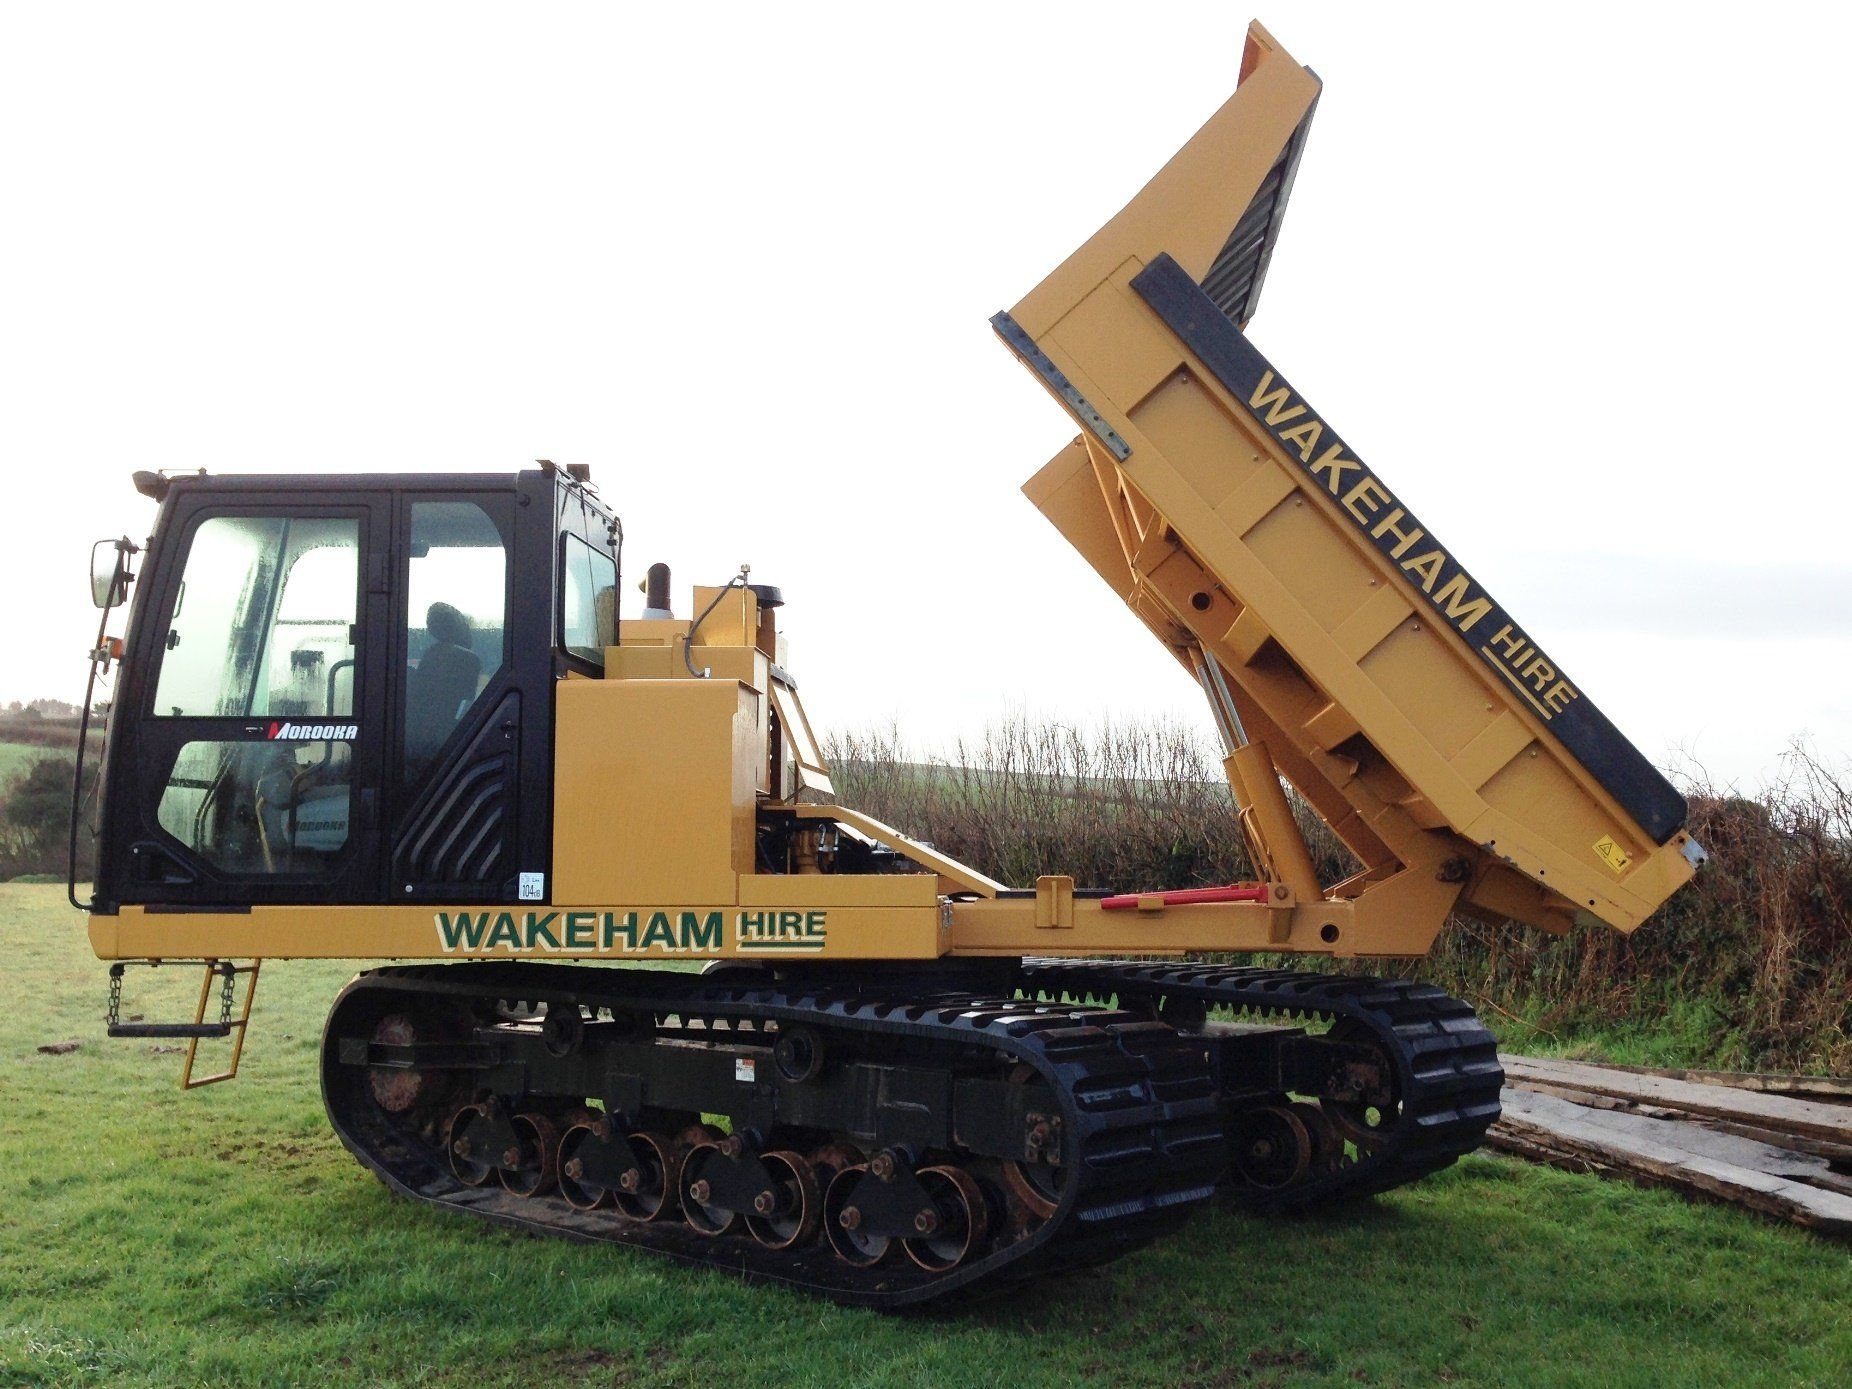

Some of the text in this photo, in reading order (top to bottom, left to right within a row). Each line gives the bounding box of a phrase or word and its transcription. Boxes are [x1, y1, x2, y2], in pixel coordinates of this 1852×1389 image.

[1248, 369, 1579, 714] WAKEHAM HIRE
[267, 721, 358, 740] MOROOKA
[433, 911, 828, 953] WAKEHAM HIRE
